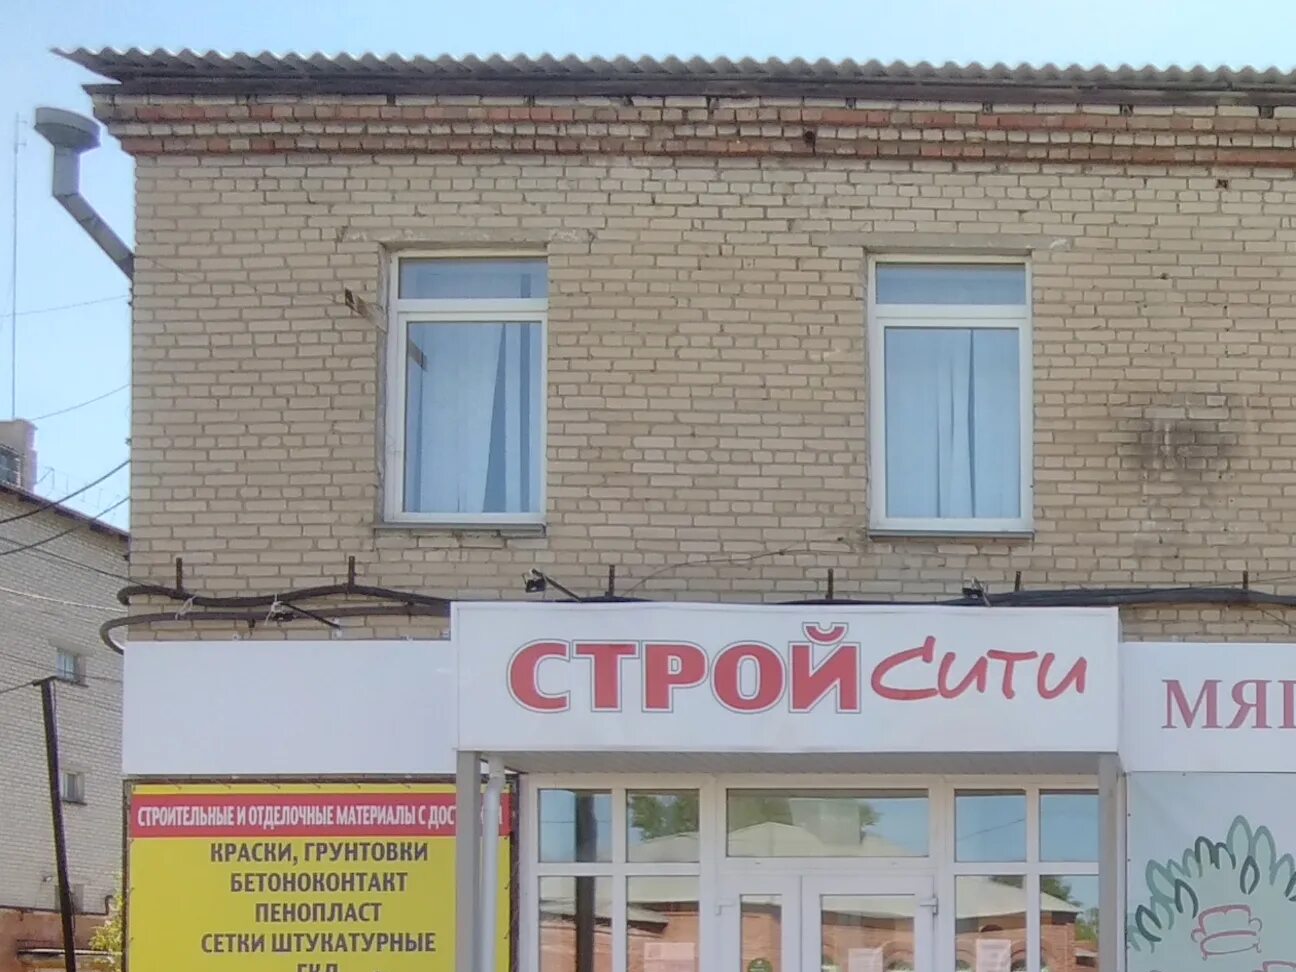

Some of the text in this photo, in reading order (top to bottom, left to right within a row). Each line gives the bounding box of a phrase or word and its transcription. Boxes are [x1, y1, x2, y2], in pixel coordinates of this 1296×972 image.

[506, 622, 862, 714] СТРОЙ
[137, 805, 235, 827] СТРОИТЕЛЬНЫЕ
[236, 805, 246, 826] И
[248, 805, 334, 830] ОТДЕЛОЧНЫЕ
[336, 805, 416, 826] МАТЕРИАЛЫ
[418, 804, 426, 825] С
[210, 842, 429, 866] КРАСКИ, ГРУНТОВКИ
[230, 872, 409, 893] БЕТОНОКОНТАКТ
[255, 902, 383, 923] ПЕНОПЛАСТ
[201, 932, 437, 954] СЕТКИ ШТУКАТУРНЫЕ
